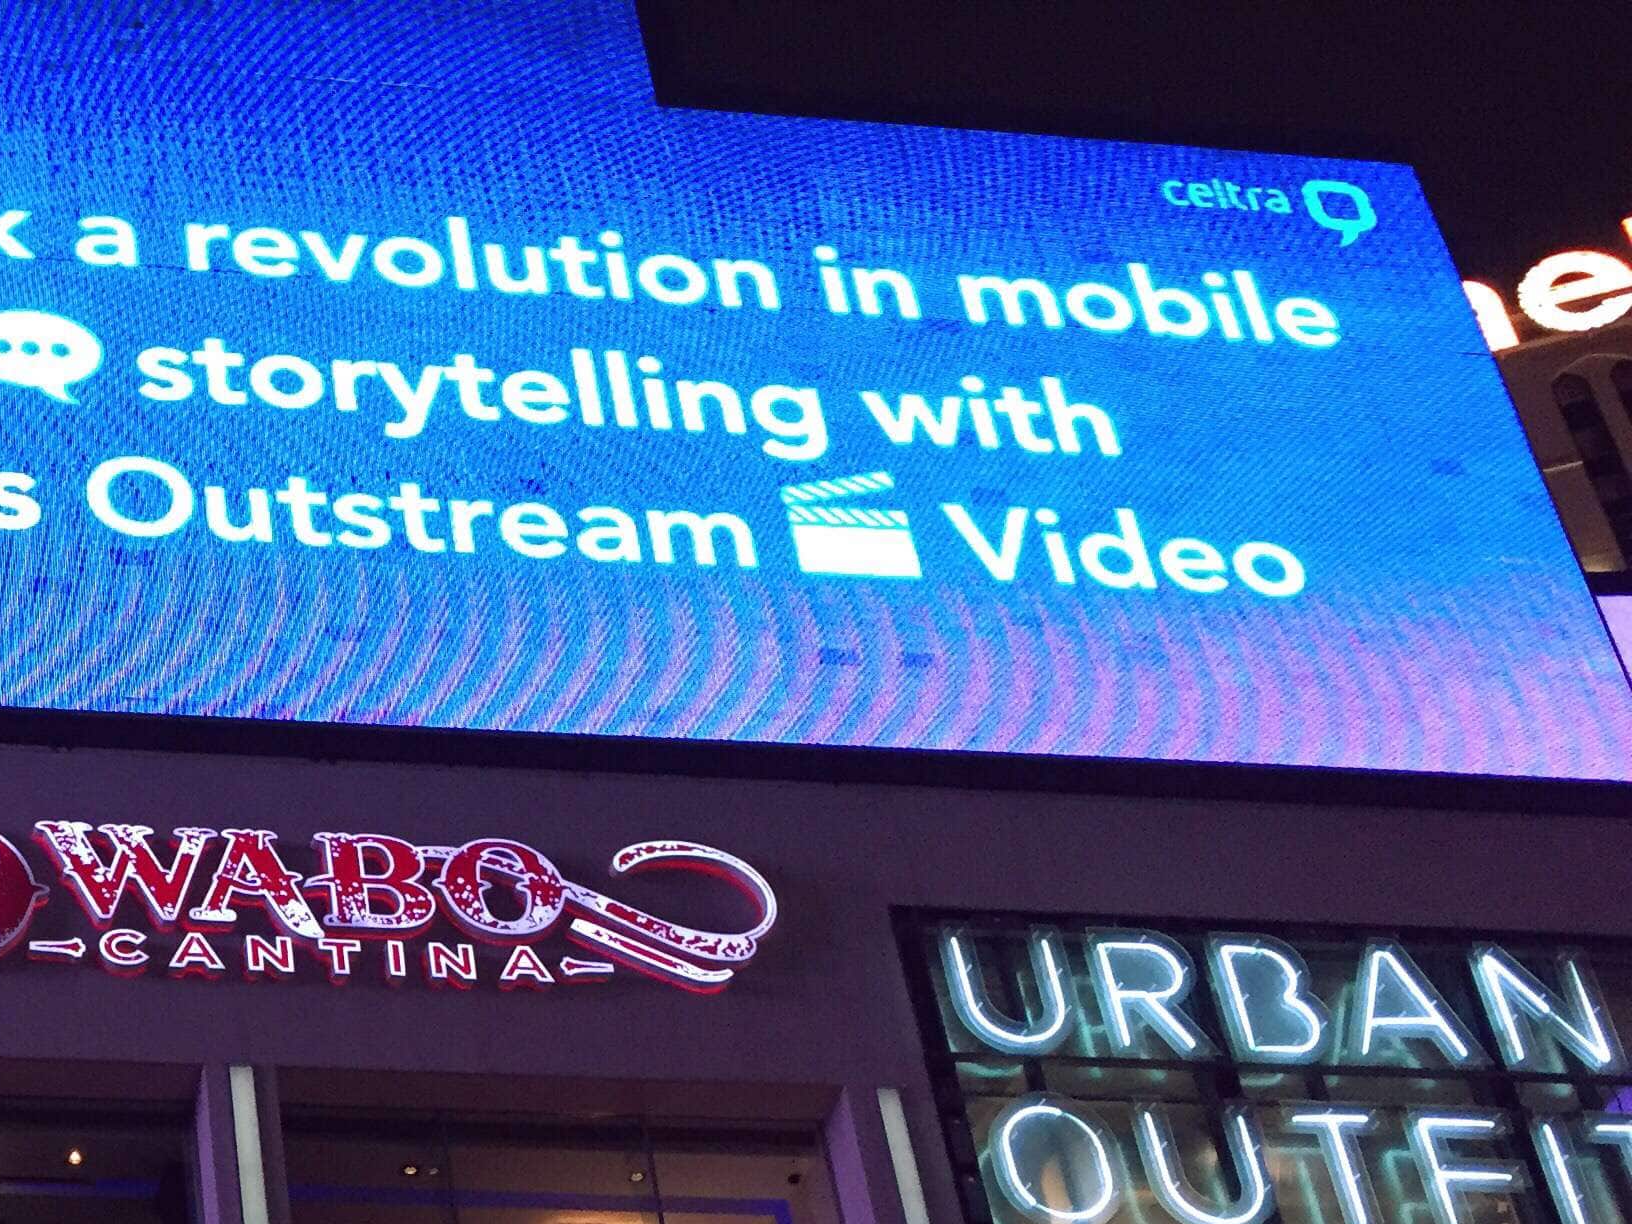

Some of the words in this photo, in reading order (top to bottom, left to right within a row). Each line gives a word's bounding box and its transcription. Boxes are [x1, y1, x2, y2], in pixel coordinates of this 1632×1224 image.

[1160, 177, 1294, 215] celtra
[73, 213, 140, 268] a
[184, 214, 782, 311] revolution
[814, 244, 921, 321] in
[958, 261, 1342, 349] mobile
[135, 336, 830, 462] storytelling
[859, 374, 1124, 458] with
[85, 454, 759, 569] Outstream
[941, 502, 1308, 600] Video
[34, 819, 573, 945] WABO
[97, 929, 556, 986] CANTINA
[943, 928, 1620, 1070] URBAN
